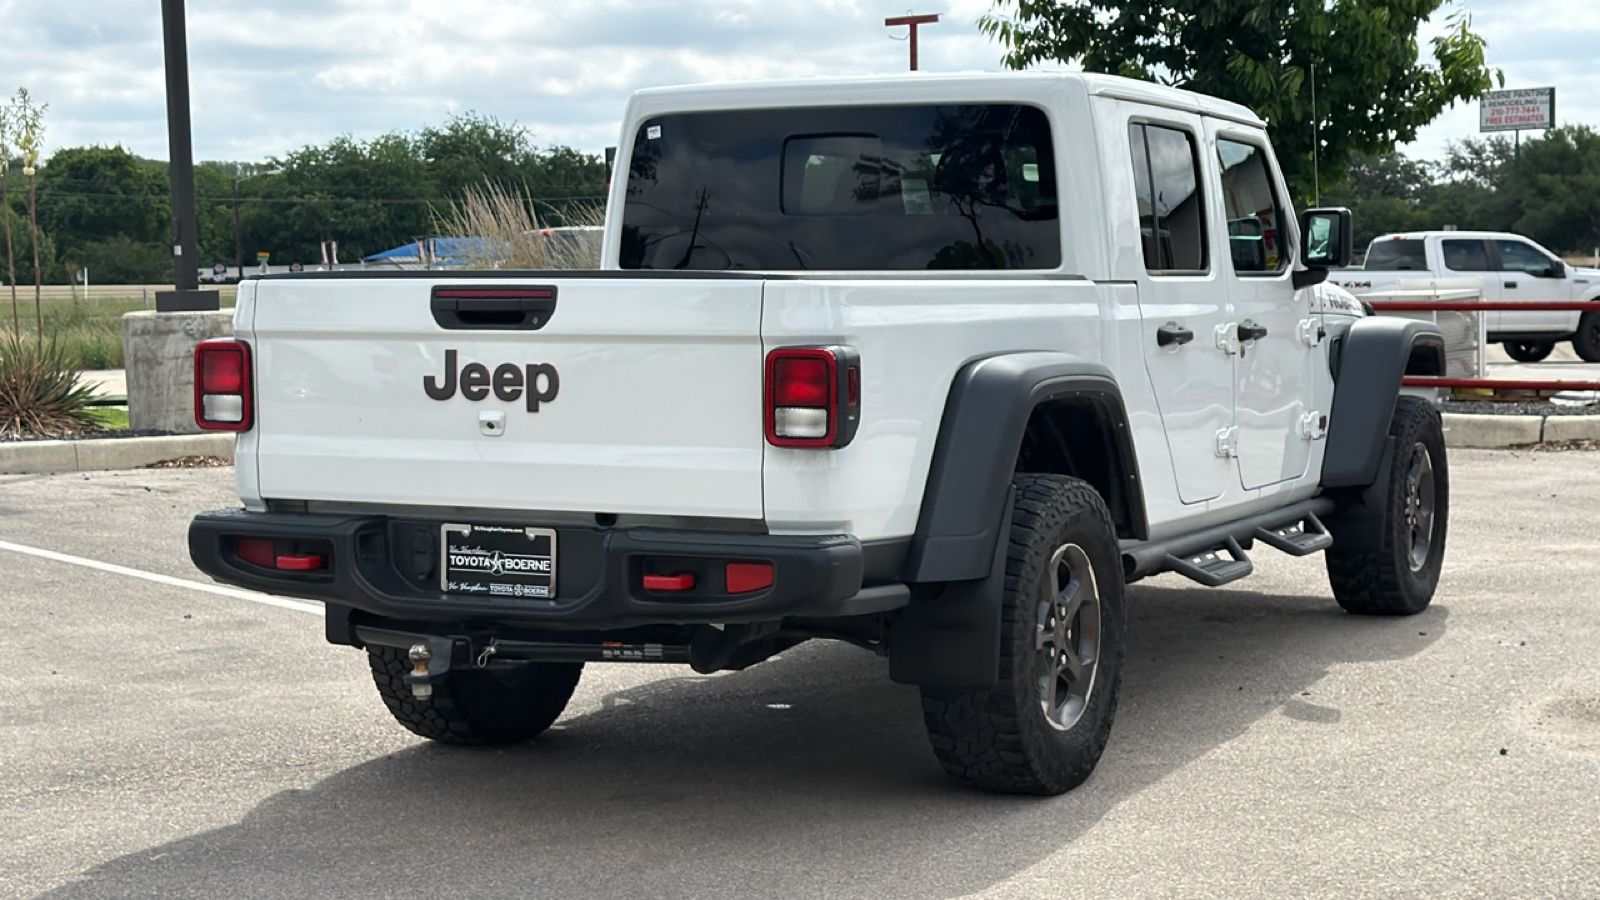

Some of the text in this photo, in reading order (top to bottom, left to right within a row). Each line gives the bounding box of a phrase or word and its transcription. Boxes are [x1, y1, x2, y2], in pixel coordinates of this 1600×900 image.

[1488, 99, 1538, 108] REMODELING
[1485, 114, 1544, 124] FREE ESTIMATES
[423, 349, 560, 413] Jeep
[449, 555, 551, 571] TOYOTA BOERNE
[490, 585, 514, 593] TOYOTA
[524, 587, 549, 596] BOERNE
